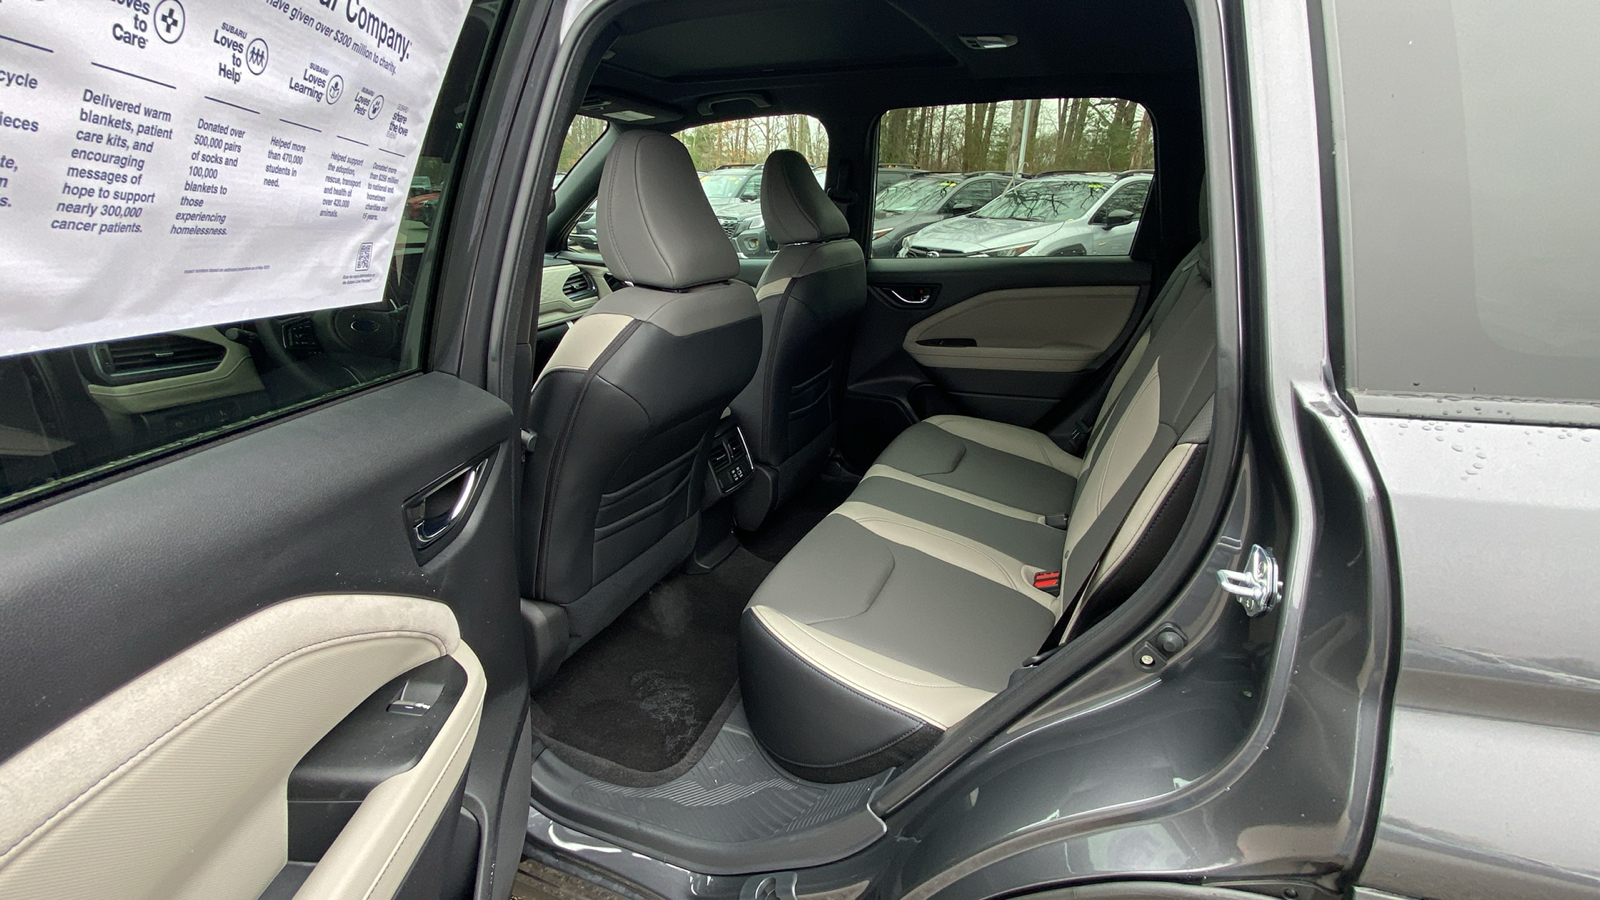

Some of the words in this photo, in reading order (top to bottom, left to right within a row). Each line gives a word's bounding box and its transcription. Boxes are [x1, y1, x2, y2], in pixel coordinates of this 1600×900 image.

[110, 0, 150, 15] ves
[133, 14, 147, 32] to
[221, 22, 247, 39] SUBARU
[112, 23, 147, 49] Care
[213, 29, 244, 54] Loves
[289, 7, 315, 28] given
[315, 21, 334, 38] over
[333, 29, 352, 48] $300
[351, 41, 373, 60] million
[373, 52, 379, 63] to
[378, 56, 396, 76] charity.
[232, 53, 242, 68] to
[309, 62, 329, 76] SUBARU
[218, 62, 241, 84] Help
[303, 69, 326, 88] Loves
[289, 77, 324, 102] Learning
[83, 89, 141, 115] Delivered
[143, 106, 171, 122] warm
[354, 92, 371, 106] Loves
[353, 103, 367, 116] Pets
[80, 108, 134, 133] blankets,
[137, 122, 173, 140] patient
[197, 118, 229, 135] Donated
[230, 127, 245, 139] over
[76, 130, 103, 144] care
[106, 132, 130, 150] kits,
[133, 140, 154, 154] and
[194, 134, 223, 149] 500,000
[223, 142, 241, 153] pairs
[270, 136, 291, 150] Helped
[291, 142, 306, 153] more
[71, 148, 145, 171] encouraging
[191, 151, 200, 161] of
[201, 153, 223, 165] socks
[224, 157, 238, 167] and
[267, 149, 281, 160] than
[282, 153, 303, 165] 470,000
[331, 151, 347, 163] Helped
[347, 157, 364, 166] support
[189, 165, 218, 179] 100,000
[265, 164, 291, 176] students
[291, 167, 297, 177] in
[327, 163, 335, 171] the
[67, 166, 127, 184] messages
[130, 174, 142, 186] of
[263, 178, 279, 187] need.
[342, 178, 361, 188] transport
[62, 183, 95, 199] hope
[98, 186, 110, 199] to
[113, 191, 155, 205] support
[184, 181, 218, 194] blankets
[220, 185, 227, 195] to
[333, 187, 347, 196] health
[56, 201, 97, 217] nearly
[100, 204, 142, 218] 300,000
[180, 196, 204, 207] those
[51, 218, 97, 232] cancer
[99, 221, 143, 235] patients.
[175, 212, 226, 225] experiencing
[170, 225, 227, 235] homelessness.
